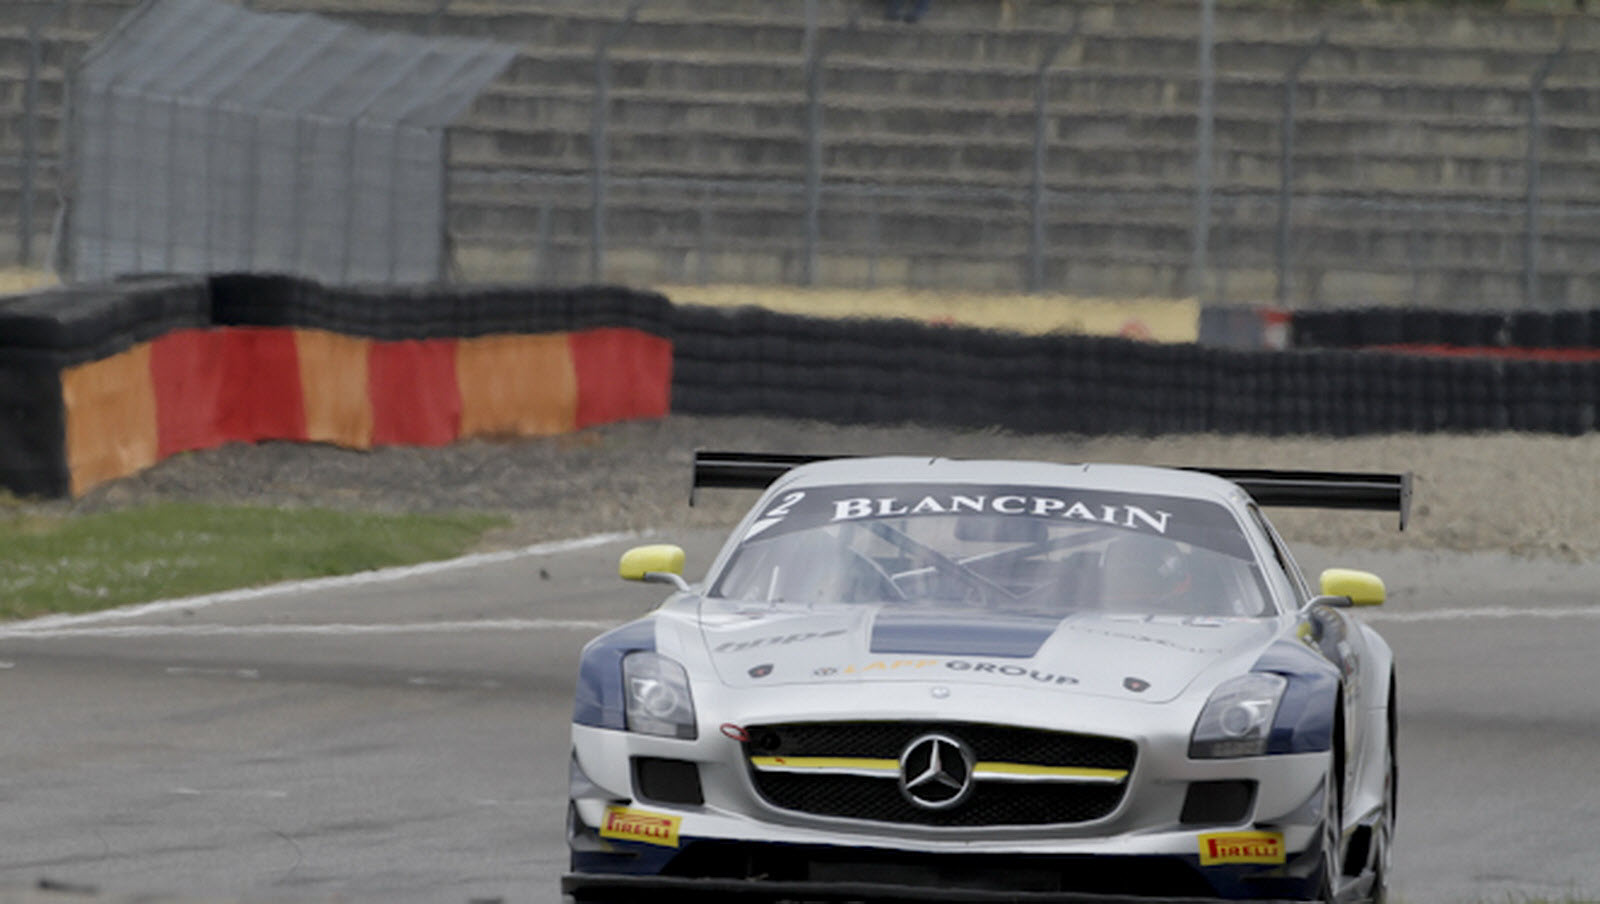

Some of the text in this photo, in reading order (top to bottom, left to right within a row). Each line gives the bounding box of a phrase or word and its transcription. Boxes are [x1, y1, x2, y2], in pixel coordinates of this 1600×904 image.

[766, 492, 806, 517] 2
[831, 495, 1173, 534] BLANCPAIN
[945, 660, 1079, 684] GROUP
[606, 811, 672, 839] PIRELLI
[1207, 838, 1278, 858] PIRELLI
